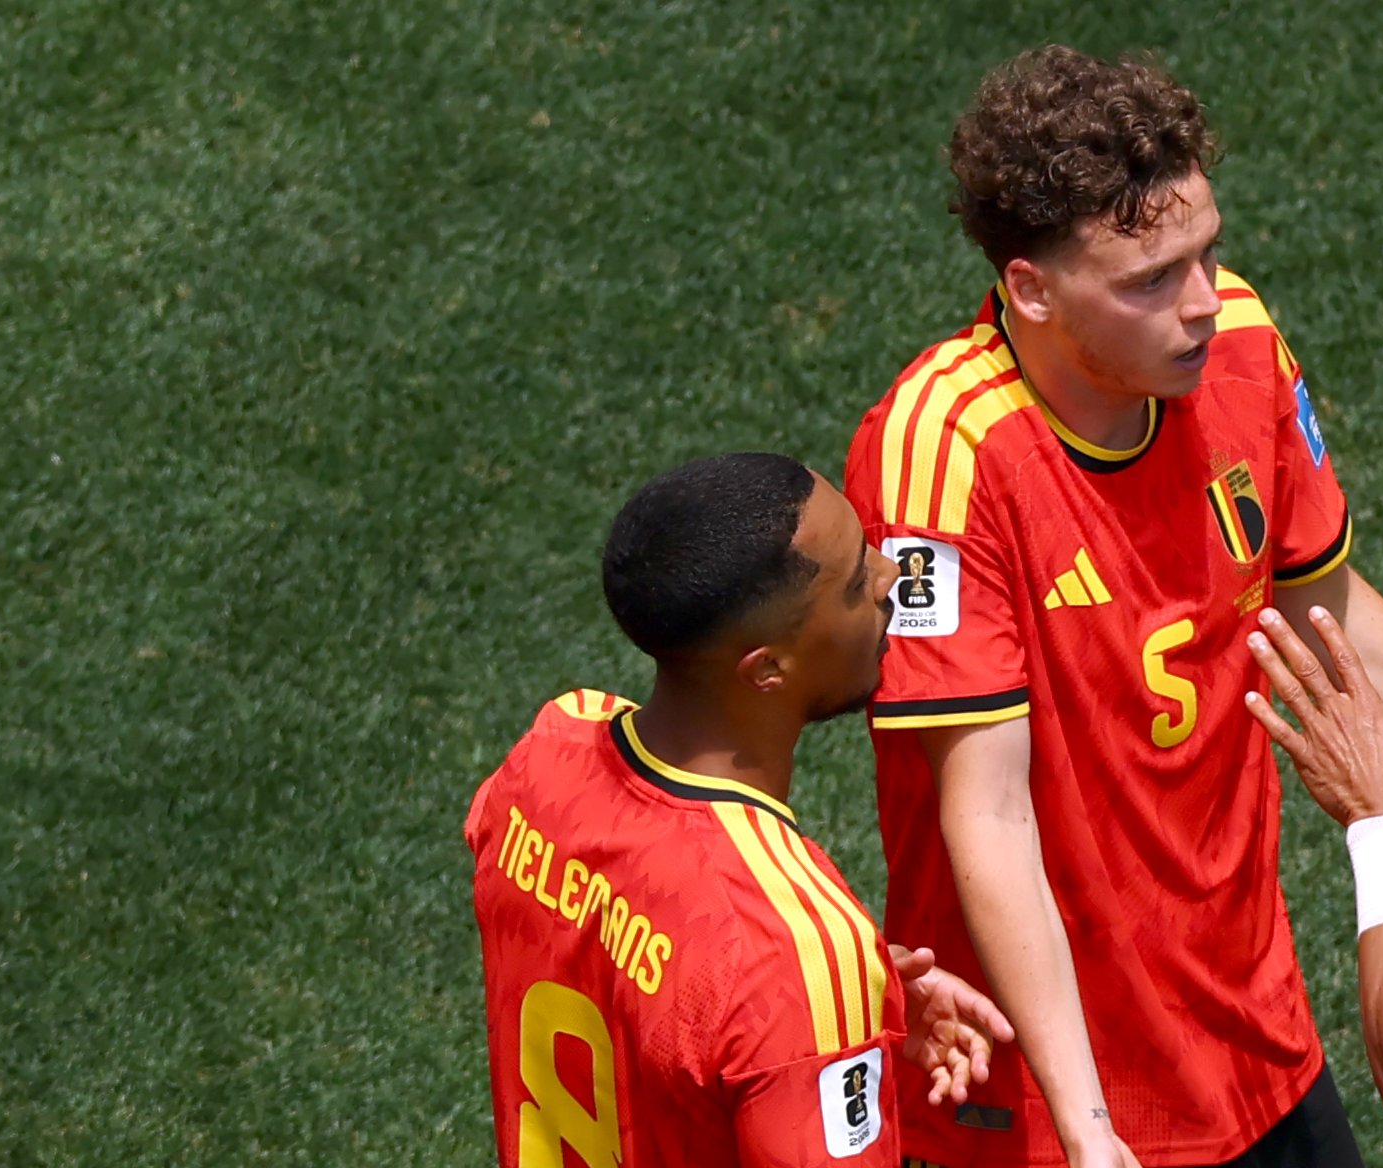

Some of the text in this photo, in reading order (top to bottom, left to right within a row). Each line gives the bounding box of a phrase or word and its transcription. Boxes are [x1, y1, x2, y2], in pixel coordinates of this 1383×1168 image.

[899, 618, 937, 627] 2026
[908, 596, 927, 604] FIFA
[1142, 618, 1197, 748] 5
[498, 806, 671, 994] TIELEMANS
